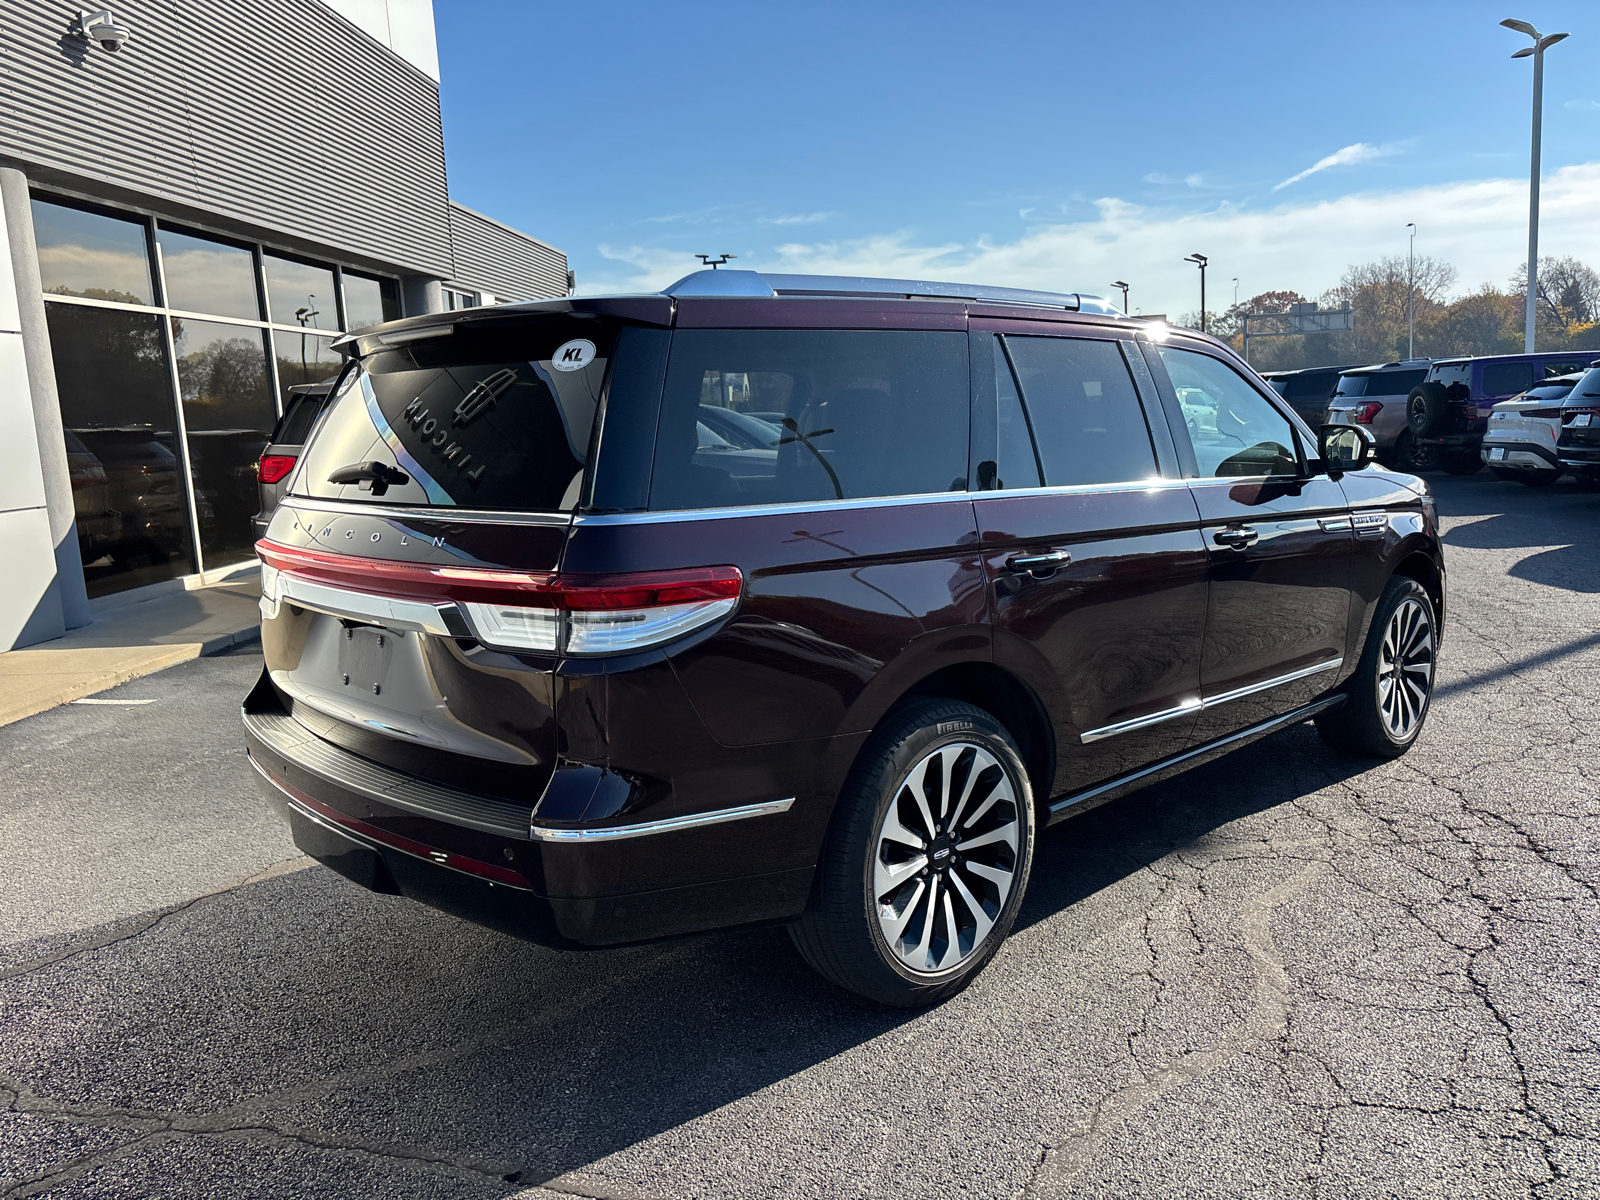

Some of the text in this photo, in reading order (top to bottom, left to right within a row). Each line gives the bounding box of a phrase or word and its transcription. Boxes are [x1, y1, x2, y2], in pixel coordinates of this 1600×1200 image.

[561, 347, 583, 362] KL
[293, 521, 446, 548] LINCOLN
[937, 721, 973, 735] PIRELLI
